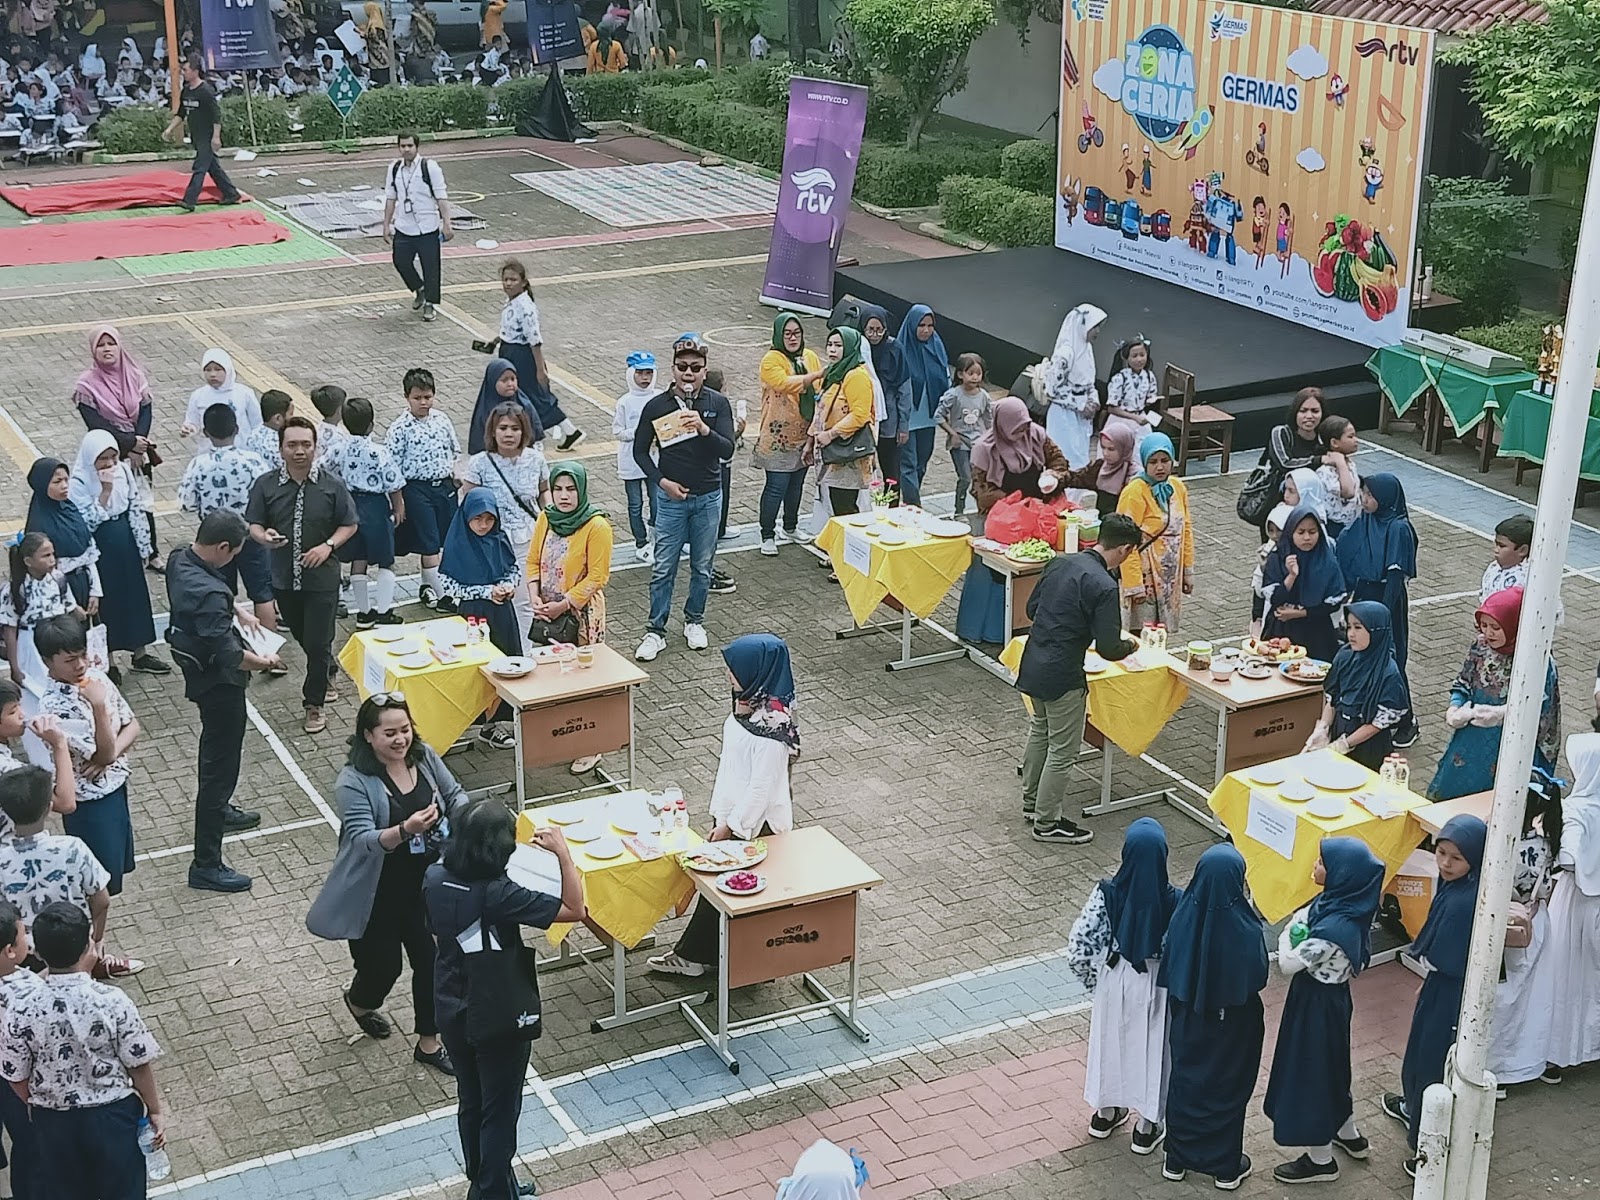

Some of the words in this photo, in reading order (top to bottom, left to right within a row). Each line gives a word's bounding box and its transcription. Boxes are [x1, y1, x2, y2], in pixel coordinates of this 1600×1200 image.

[1125, 44, 1195, 89] ZONA
[1388, 40, 1419, 66] rtv
[1121, 79, 1194, 122] CERIA
[1222, 75, 1298, 112] GERMAS
[796, 187, 834, 215] rtv
[551, 721, 596, 737] 05/2013
